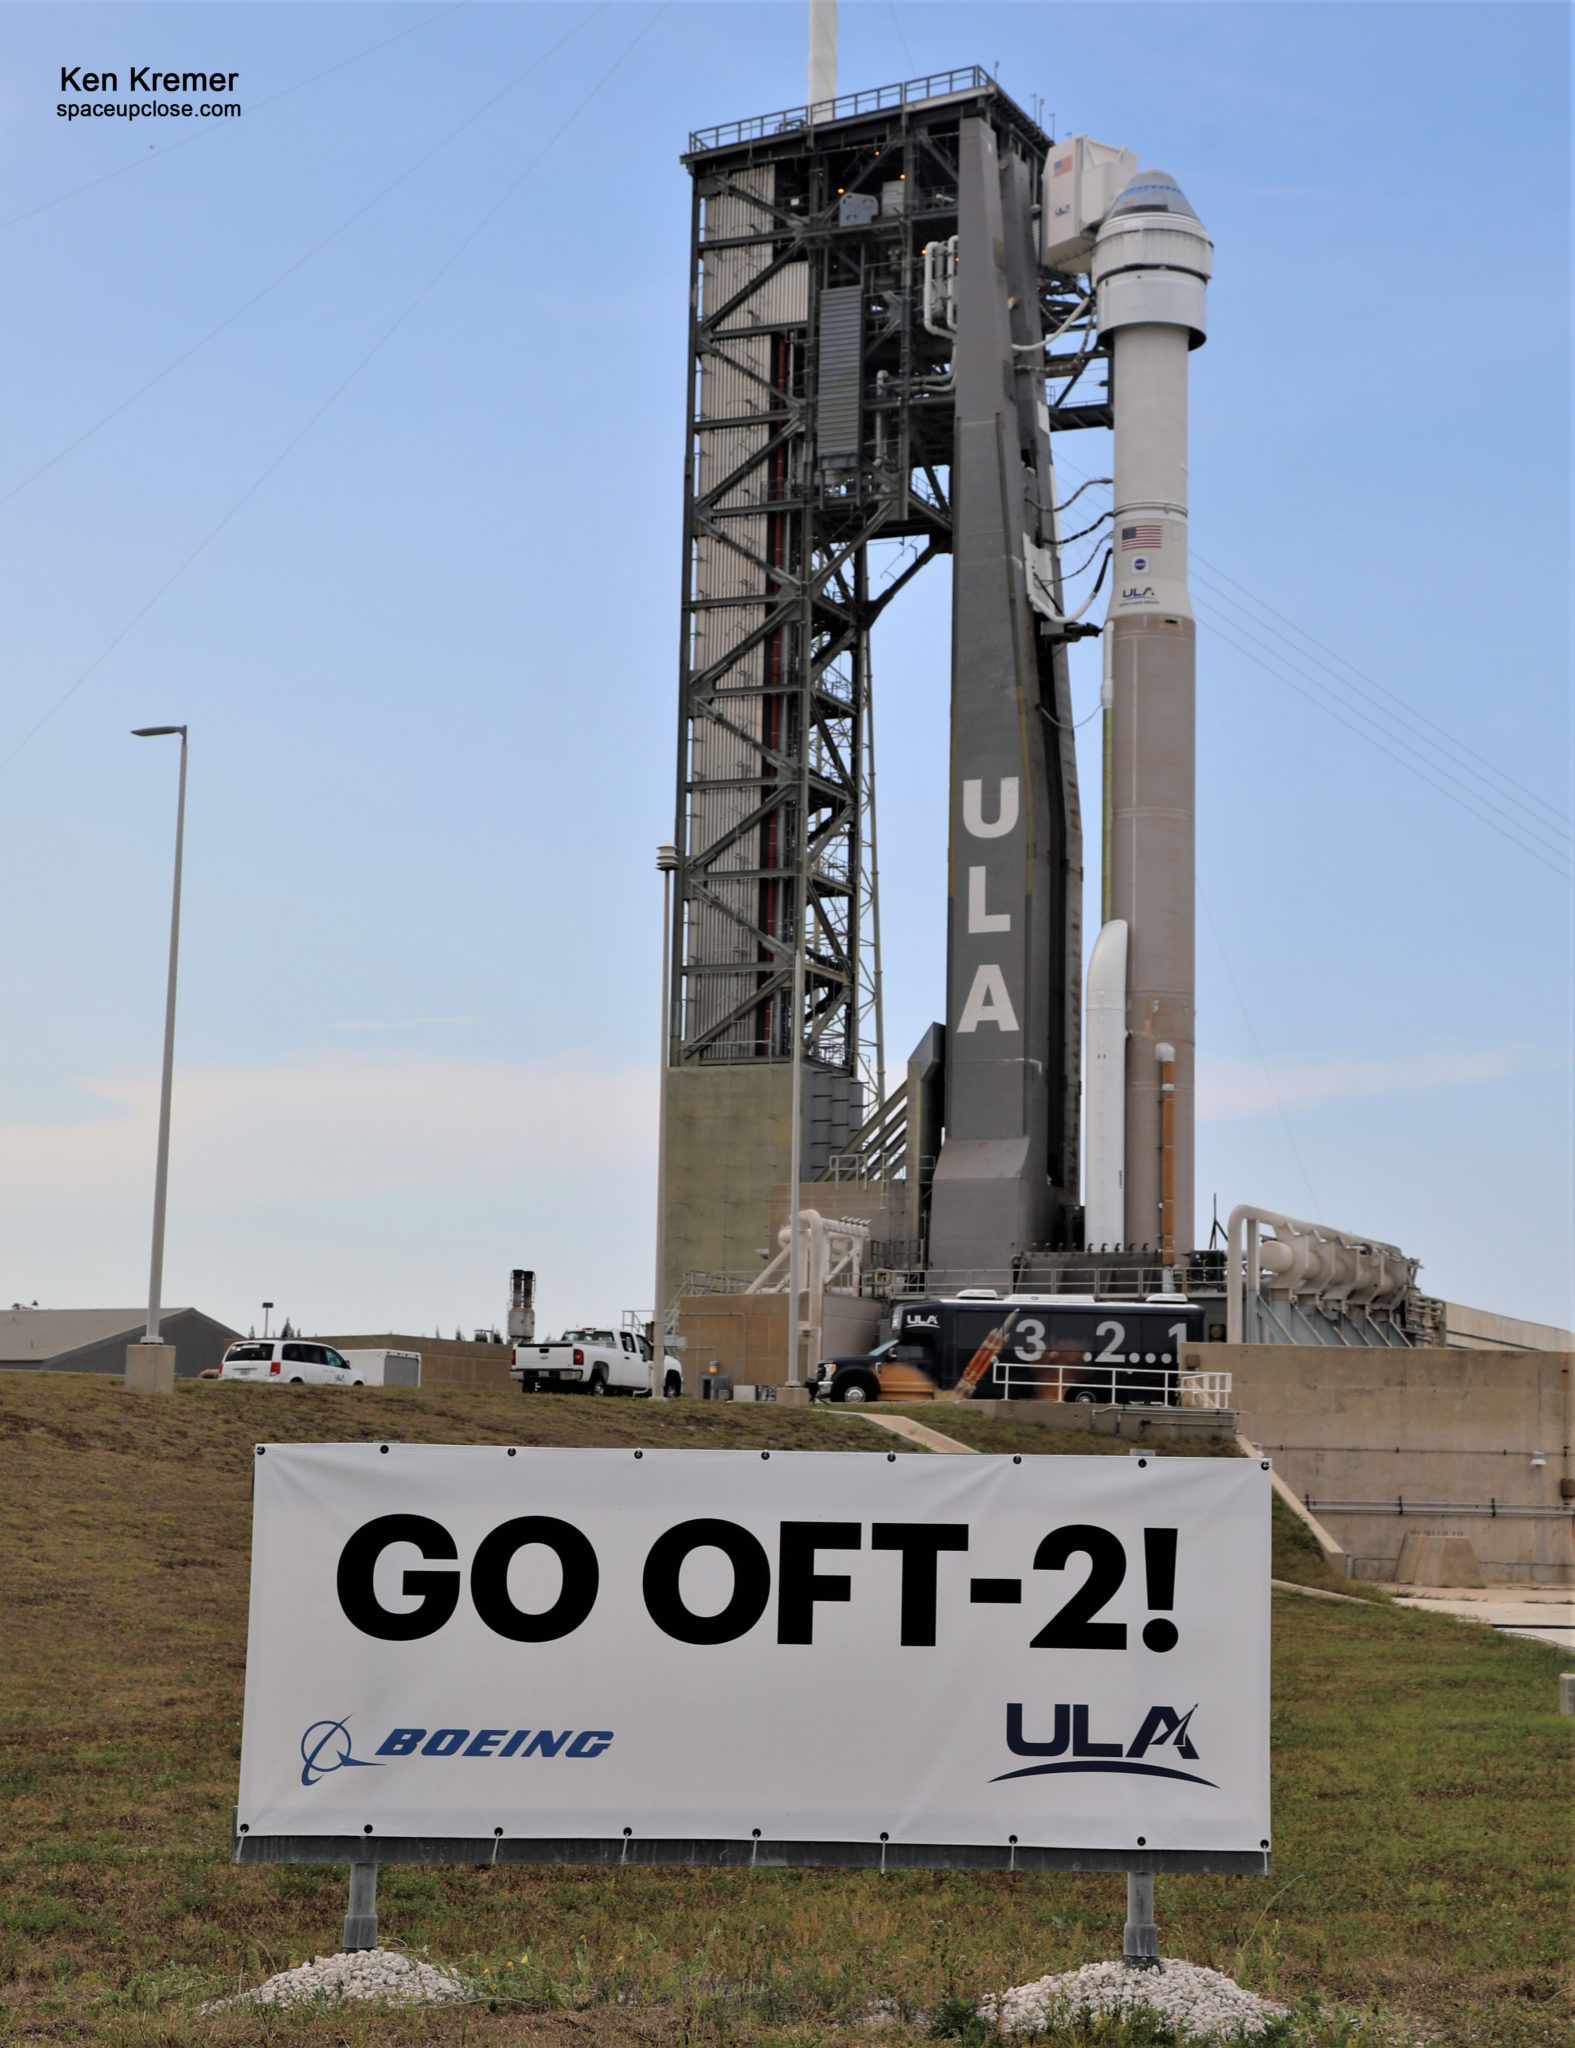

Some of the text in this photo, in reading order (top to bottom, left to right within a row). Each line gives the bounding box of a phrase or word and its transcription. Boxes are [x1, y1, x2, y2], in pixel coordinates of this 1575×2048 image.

[1122, 586, 1156, 598] ULA
[956, 776, 1020, 1033] ULA
[906, 1314, 939, 1325] ULA
[336, 1513, 1179, 1654] GO OFT-2!
[374, 1727, 615, 1760] BOEING
[1006, 1702, 1200, 1760] ULA
